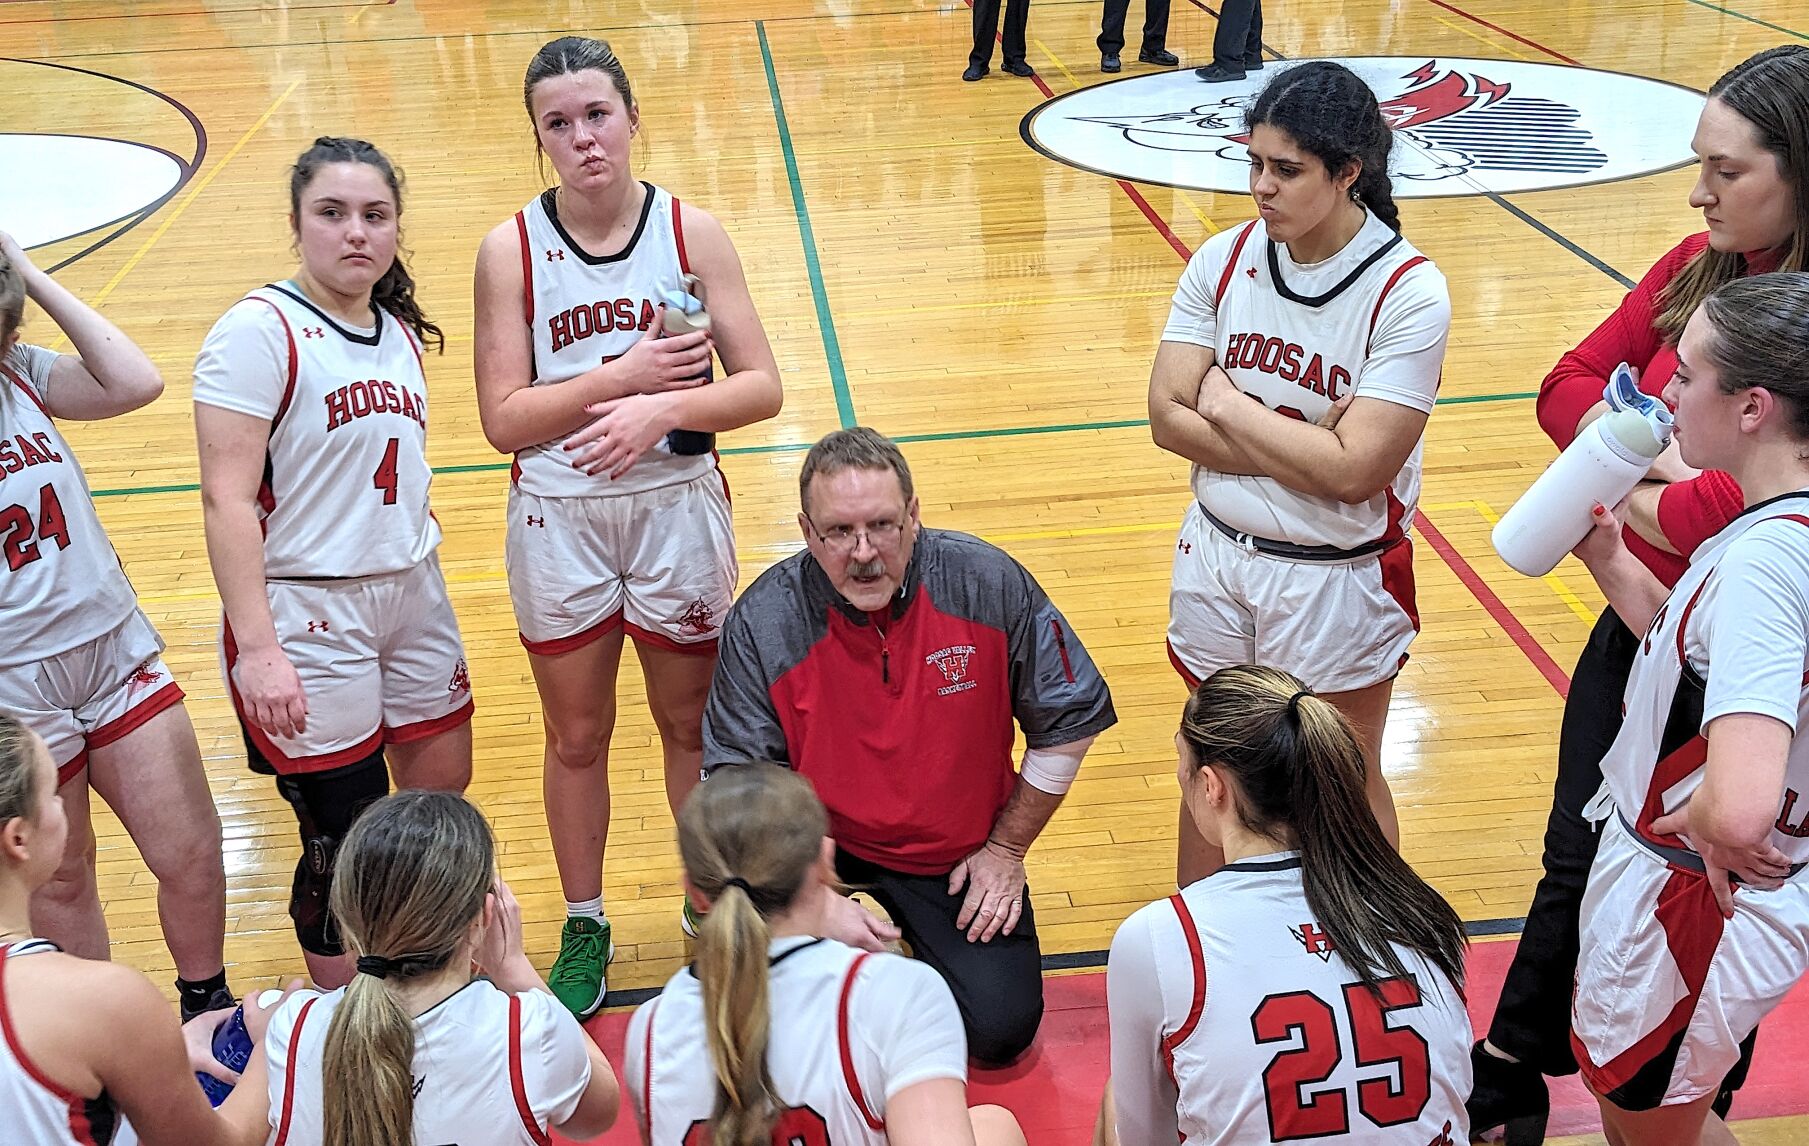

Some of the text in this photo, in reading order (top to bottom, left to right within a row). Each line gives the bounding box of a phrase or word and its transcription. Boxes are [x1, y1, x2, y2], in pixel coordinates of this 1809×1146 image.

[549, 298, 667, 354] HOOSA
[1224, 332, 1352, 402] HOOSAC
[324, 379, 427, 433] HOOSAC
[373, 437, 400, 506] 4
[0, 482, 72, 572] 24
[1250, 972, 1432, 1143] 25
